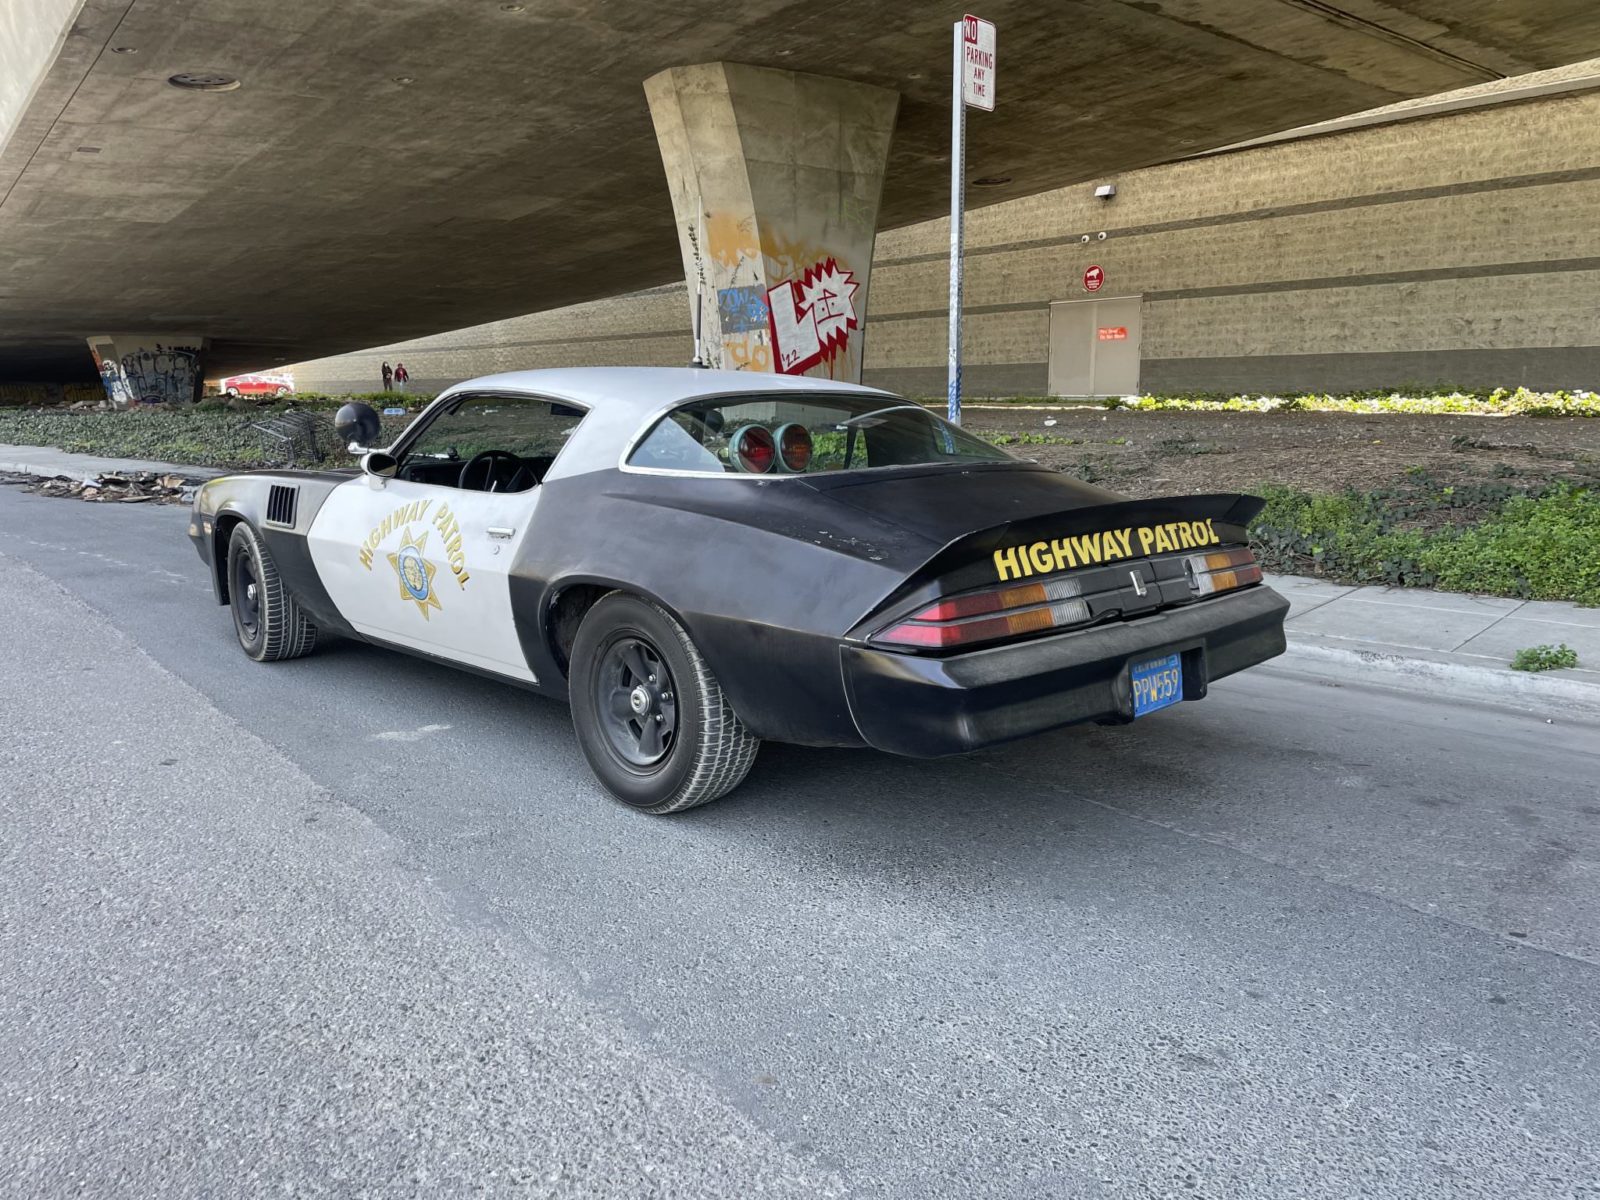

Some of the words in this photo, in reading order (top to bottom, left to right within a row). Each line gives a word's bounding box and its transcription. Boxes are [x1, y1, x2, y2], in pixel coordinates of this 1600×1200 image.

[965, 19, 977, 41] NO
[966, 46, 993, 69] PARKING
[974, 67, 985, 81] ANY
[973, 82, 985, 97] TIME
[360, 499, 433, 571] HIGHWAY
[432, 501, 470, 591] PATROL
[993, 527, 1134, 581] HIGHWAY
[1138, 518, 1220, 556] PATROL
[1133, 669, 1179, 708] PPW559
